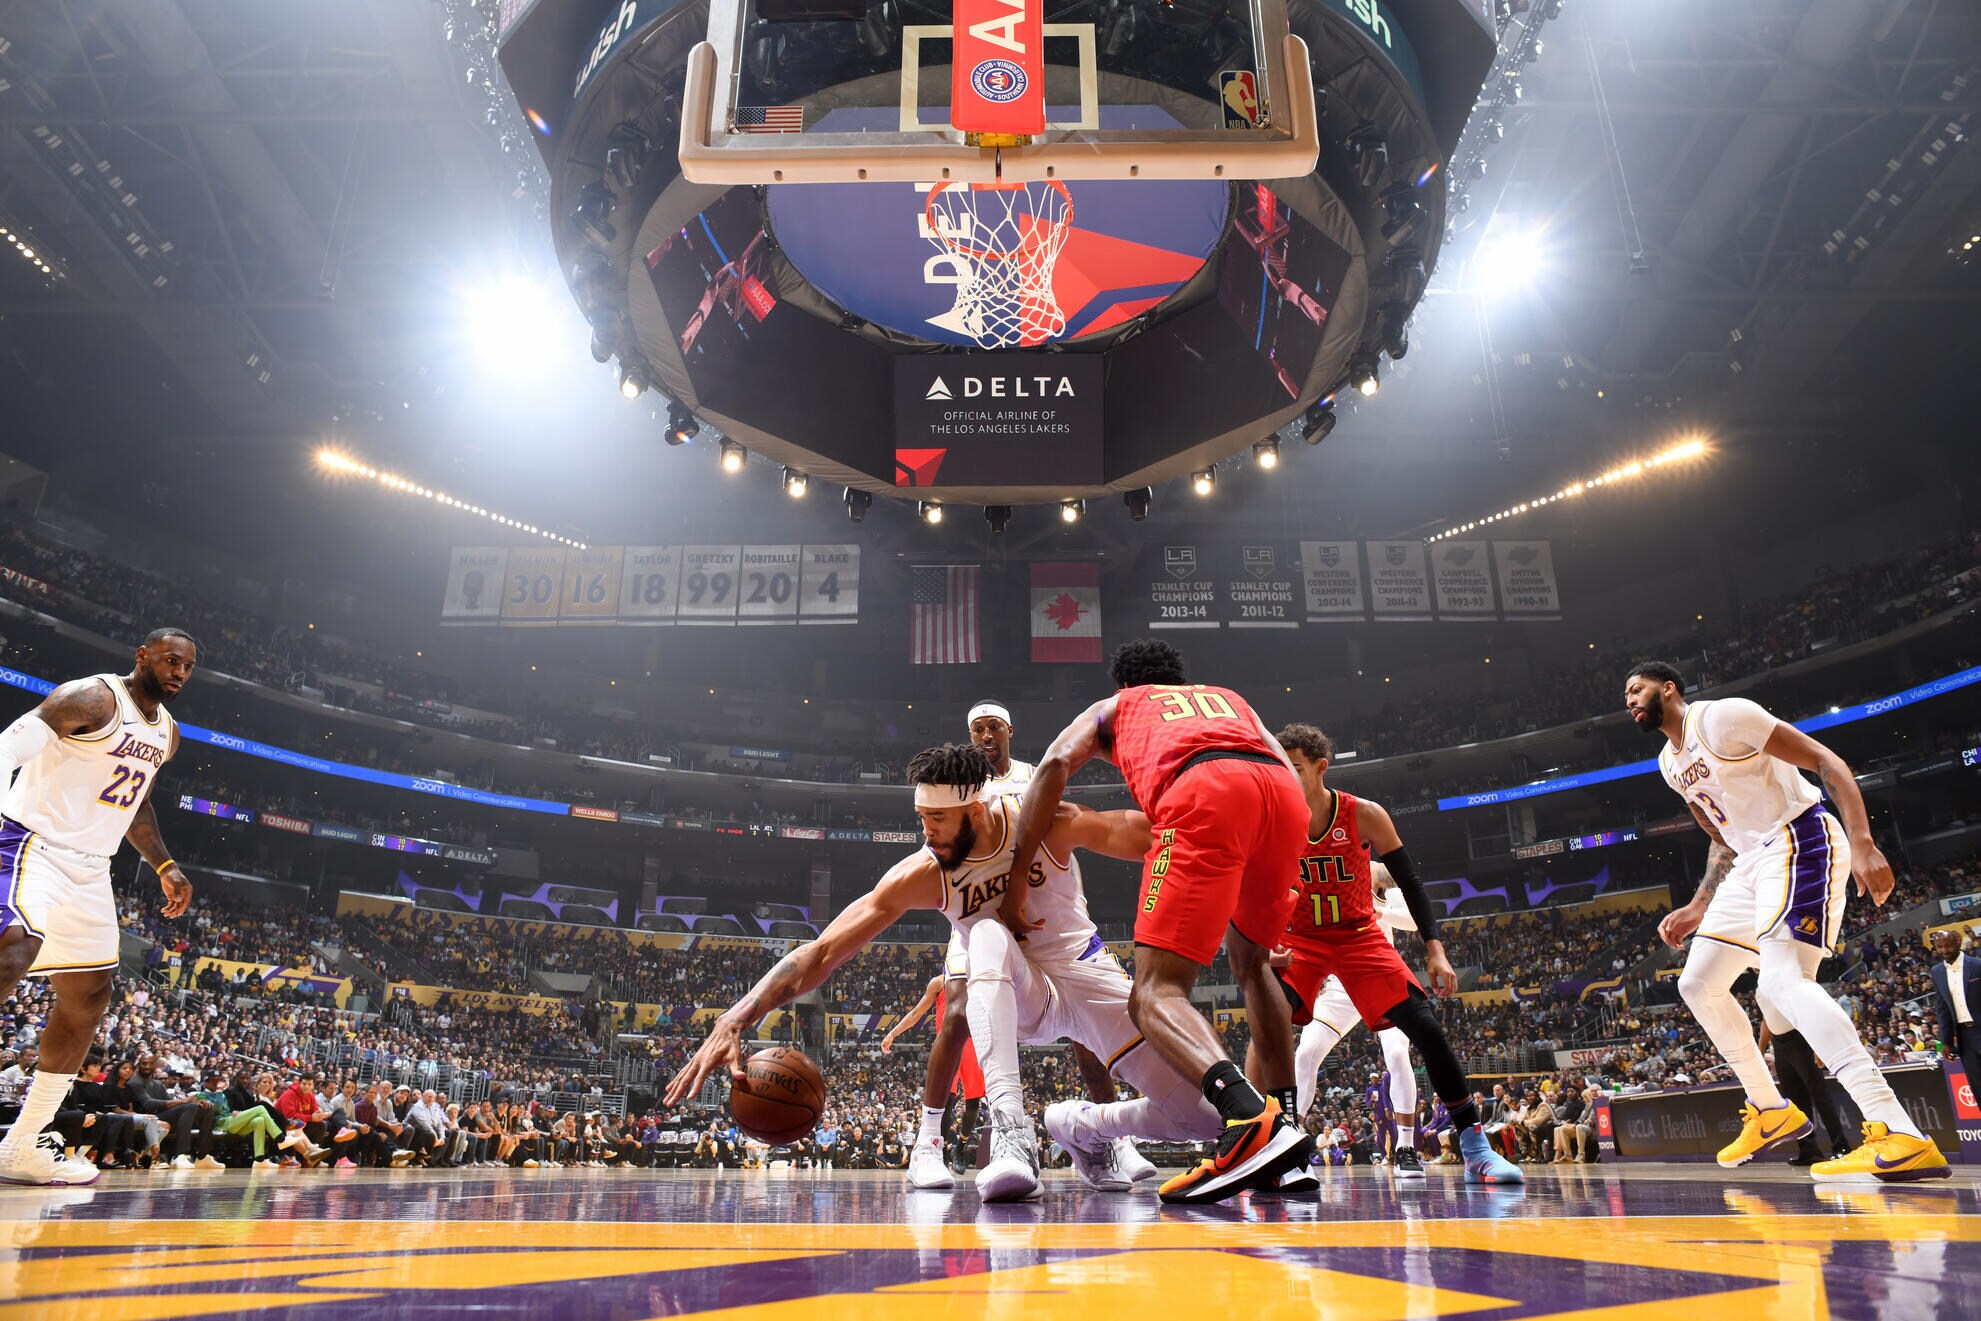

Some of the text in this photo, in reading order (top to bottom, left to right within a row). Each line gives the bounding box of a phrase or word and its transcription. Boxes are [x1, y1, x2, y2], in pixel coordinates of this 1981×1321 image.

[974, 62, 994, 98] AUTOMOBILE CLUB
[991, 72, 1004, 90] AAA
[997, 61, 1025, 100] SOUTHERN CALIFORNIA
[964, 376, 1075, 397] DELTA
[943, 411, 1056, 421] OFFICIAL AIRLINE OF
[930, 424, 1070, 434] THE LOS ANGELES LAKERS
[633, 554, 672, 565] TAYLOR
[687, 554, 735, 564] GRETZKY
[744, 554, 798, 564] ROBITAILLE
[814, 554, 849, 564] BLAKE
[1167, 550, 1193, 560] LA
[1246, 550, 1271, 560] LA
[687, 572, 732, 603] 99
[745, 572, 792, 603] 20
[817, 571, 839, 603] 4
[1152, 582, 1213, 591] STANLEY CUP
[1230, 582, 1291, 590] STANLEY CUP
[1374, 578, 1424, 586] CONFERENCE
[511, 575, 553, 605] 30
[573, 574, 607, 604] 16
[631, 573, 666, 604] 18
[1311, 587, 1356, 595] CHAMPIONS
[1442, 586, 1487, 594] CHAMPIONS
[1152, 592, 1214, 602] CHAMPIONS
[1231, 592, 1293, 601] CHAMPIONS
[1318, 598, 1351, 607] 2013-14
[1385, 597, 1418, 606] 2011-12
[1161, 606, 1207, 617] 2013-14
[1241, 605, 1285, 617] 2011-12
[1149, 691, 1241, 722] 30
[1865, 695, 1903, 714] zoom
[1909, 687, 1933, 700] Video
[106, 732, 164, 768] LAKERS
[210, 732, 331, 771] zoom Video Communications
[1961, 748, 1978, 758] CHI
[1963, 757, 1977, 766] LA
[97, 764, 146, 810] 23
[1467, 779, 1579, 805] zoom Video Communications
[411, 779, 526, 808] zoom Video Communications
[181, 795, 193, 803] NE
[209, 801, 218, 809] 17
[179, 802, 250, 823] PHI 10 NFL
[575, 807, 616, 819] WELLS FARGO
[1390, 803, 1432, 816] Spectrum
[1695, 792, 1729, 827] 3
[262, 814, 310, 833] TOSHIBA
[321, 829, 358, 839] BUD LIGHT
[372, 833, 385, 841] CIN
[838, 832, 870, 840] DELTA
[873, 833, 915, 843] STAPLES
[1623, 833, 1638, 841] NFL
[1568, 837, 1582, 845] CIN
[425, 848, 439, 856] NFL
[1517, 842, 1562, 858] STAPLES
[457, 851, 490, 862] DELTA
[1144, 829, 1175, 912] HAWKS
[1310, 893, 1340, 926] 11
[387, 903, 455, 930] LOS
[462, 992, 561, 1012] LOS ANGELES
[1627, 1119, 1656, 1138] UCLA
[1660, 1112, 1707, 1140] Health
[1599, 1142, 1615, 1150] TOYOTA
